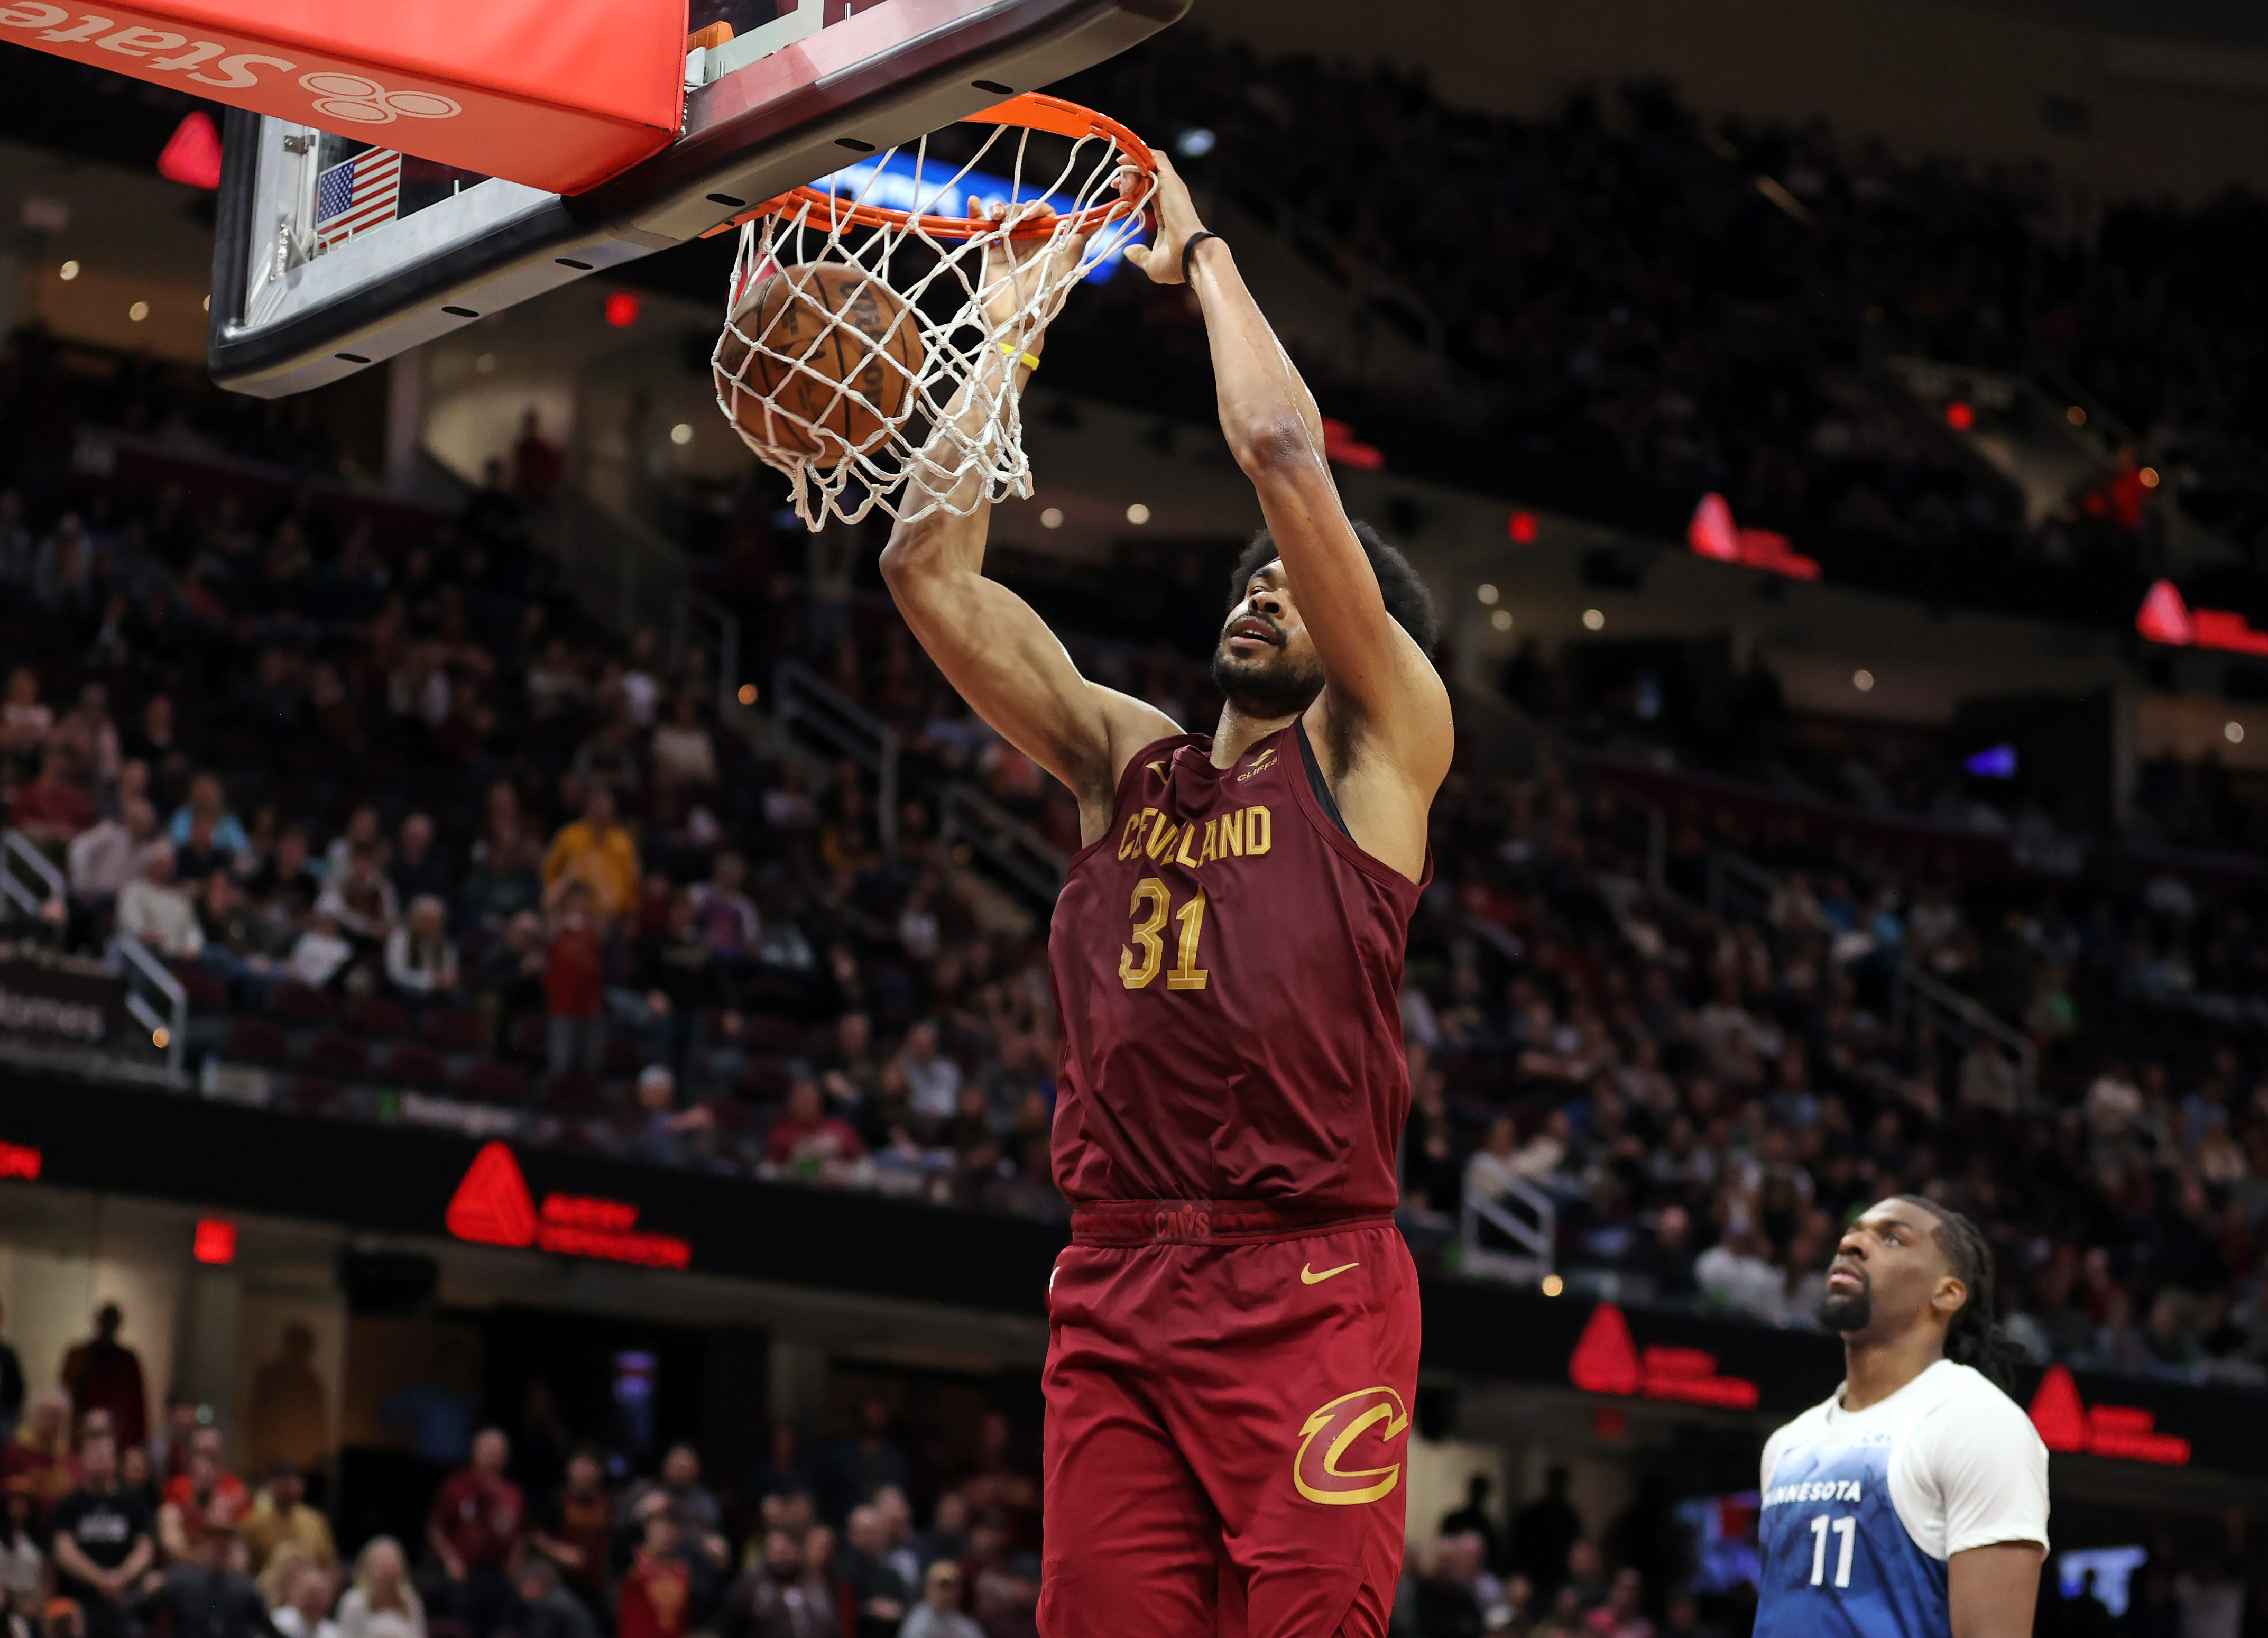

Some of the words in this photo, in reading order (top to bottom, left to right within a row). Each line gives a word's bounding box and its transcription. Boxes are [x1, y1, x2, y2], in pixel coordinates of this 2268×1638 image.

[0, 1, 297, 88] State
[1237, 756, 1277, 781] CLIFFS
[1119, 878, 1209, 989] 31
[1155, 1209, 1209, 1238] CAVS
[1811, 1514, 1856, 1588] 11
